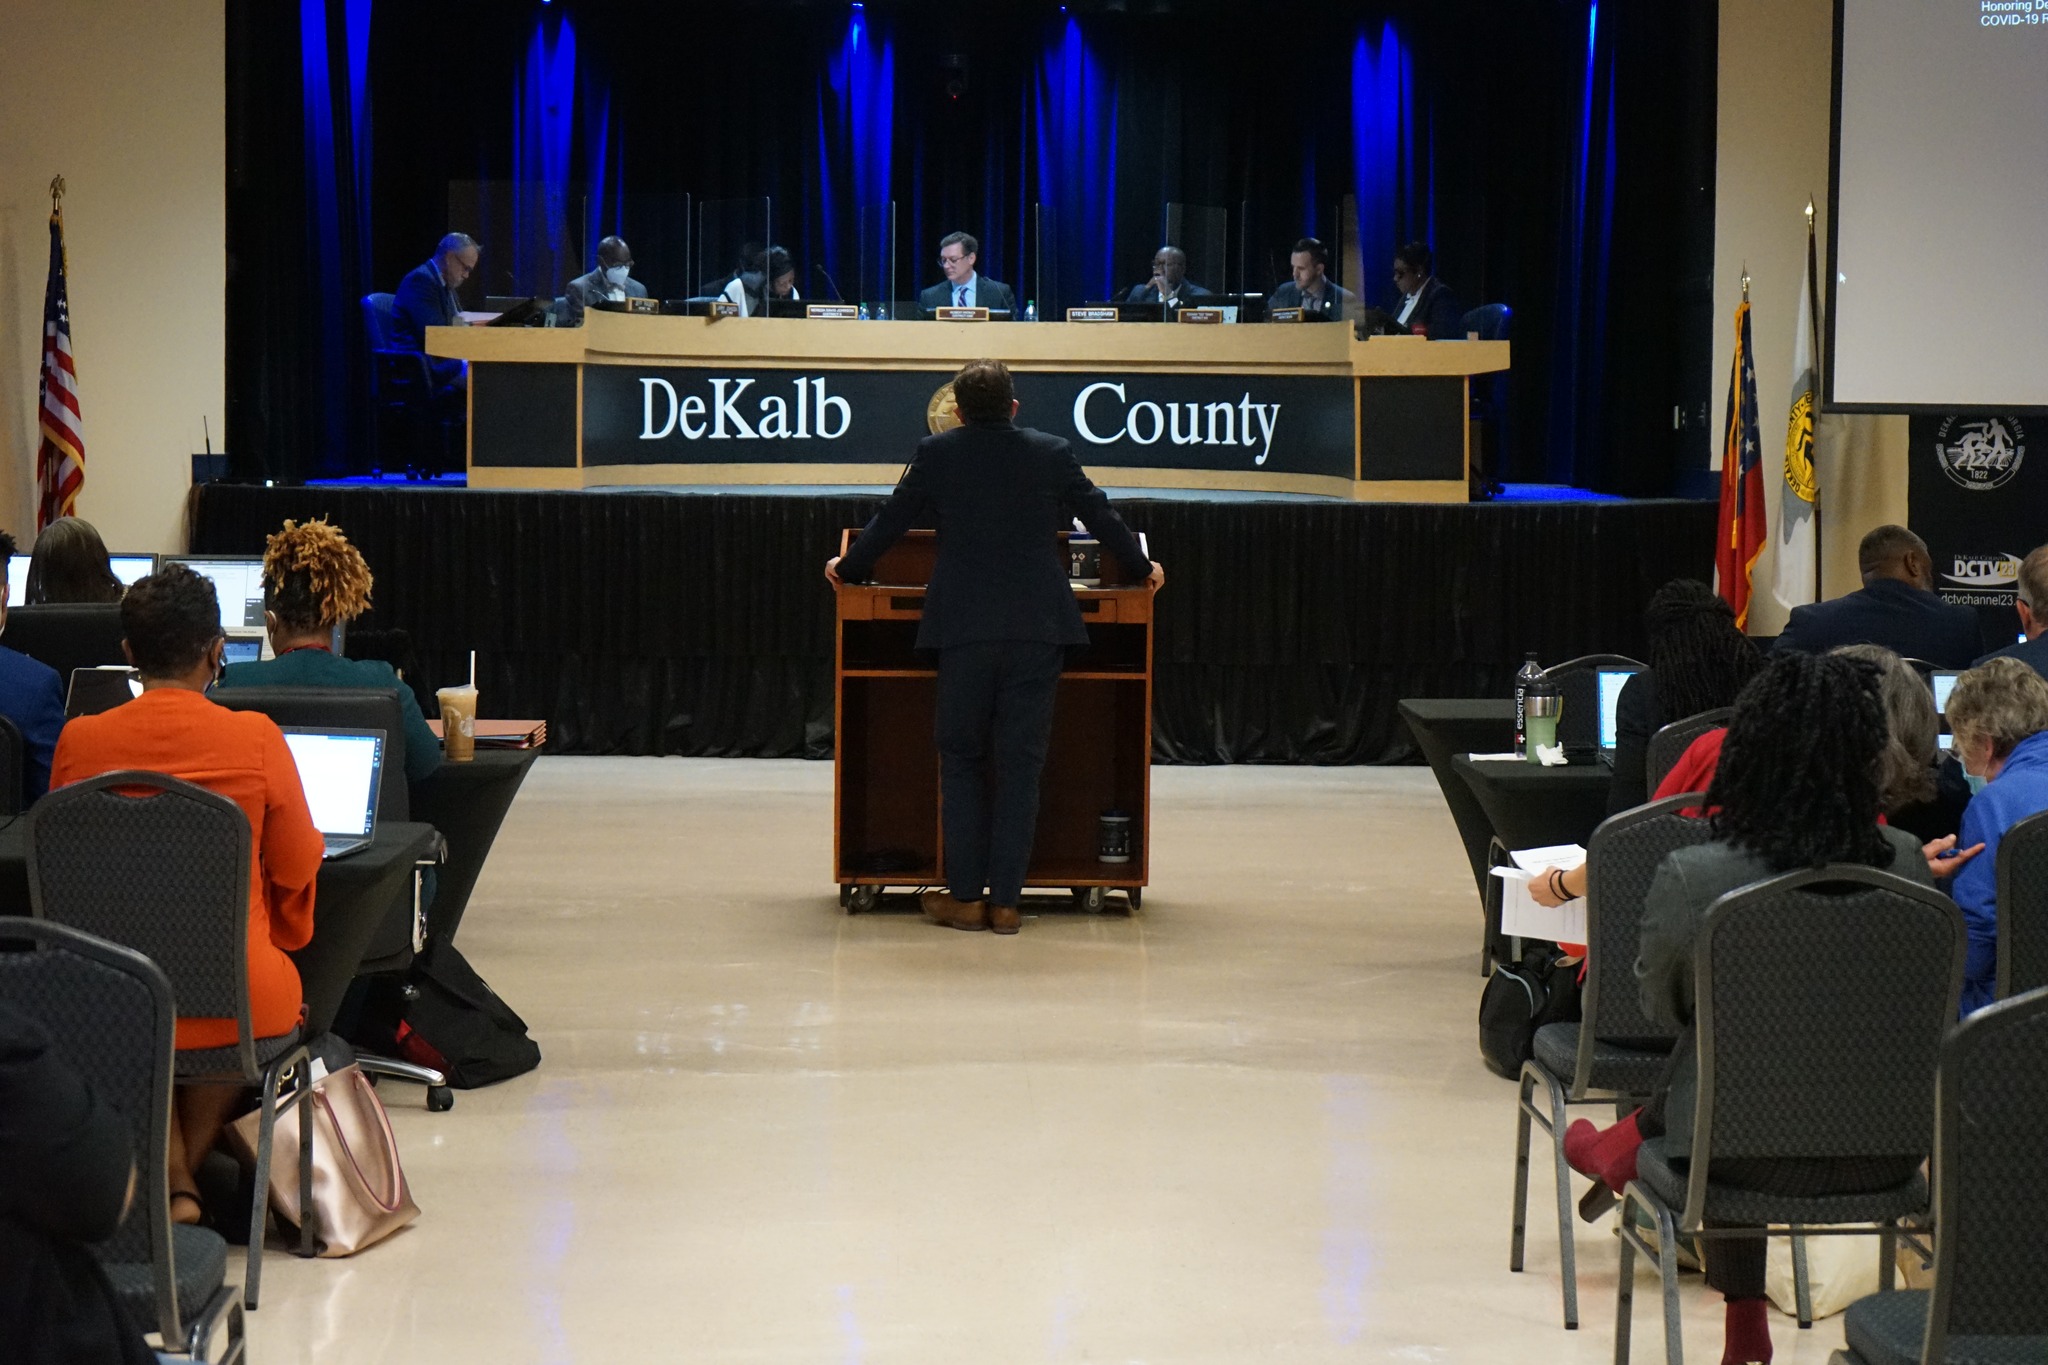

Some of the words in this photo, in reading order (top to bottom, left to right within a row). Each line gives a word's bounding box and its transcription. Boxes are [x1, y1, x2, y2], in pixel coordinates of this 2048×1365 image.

[1981, 0, 2032, 12] Honoring
[1981, 14, 2039, 26] COVID-19
[638, 376, 852, 440] DeKalb
[1073, 382, 1281, 466] County
[1938, 414, 1958, 438] DEKAL
[2006, 415, 2025, 440] ORGIA
[1970, 470, 1988, 479] 1822
[1941, 592, 2018, 606] dctvchannel23.
[1516, 688, 1524, 730] essentia
